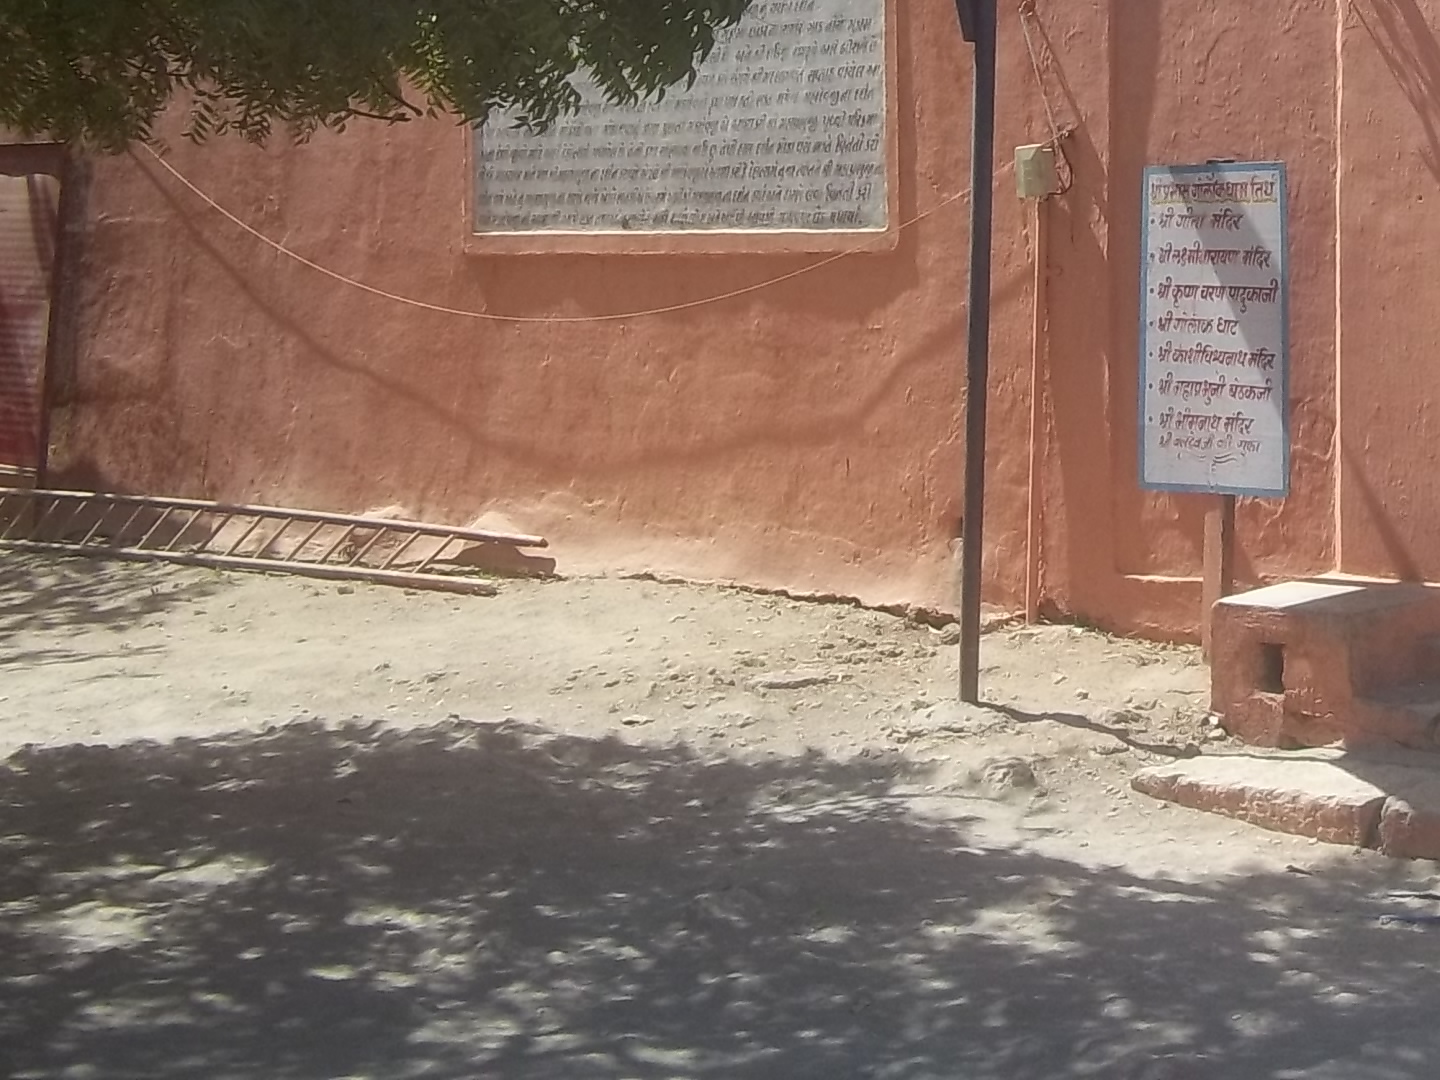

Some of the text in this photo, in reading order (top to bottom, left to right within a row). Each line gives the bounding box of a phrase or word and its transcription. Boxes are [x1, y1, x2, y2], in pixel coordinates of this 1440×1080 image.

[1158, 206, 1174, 228] श्री
[1211, 208, 1243, 231] मंदिर
[1158, 242, 1172, 264] श्री
[1241, 245, 1272, 269] मंदिर
[1158, 276, 1172, 302] श्री
[1158, 310, 1172, 333] श्री
[1158, 340, 1172, 362] श्री
[1247, 346, 1276, 370] मंदिर
[1158, 371, 1173, 395] श्री
[1159, 406, 1174, 429] श्री
[1224, 411, 1255, 435] मंदिर
